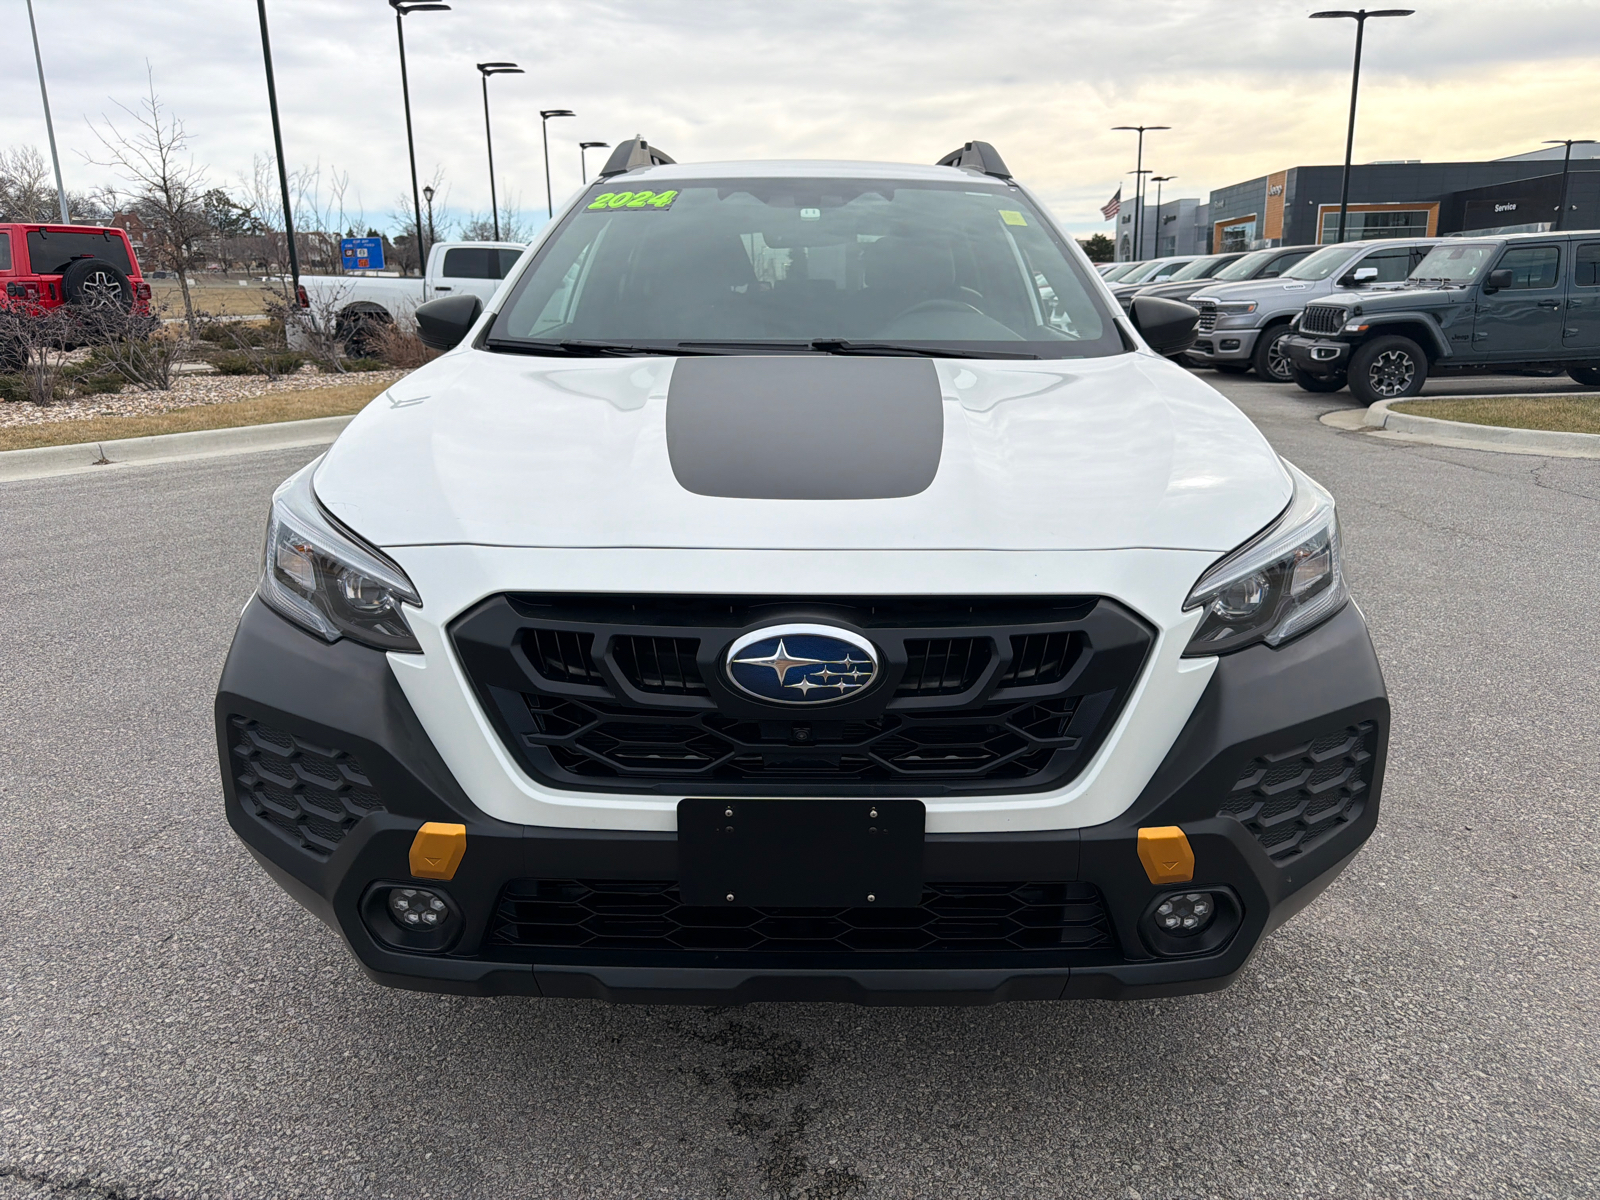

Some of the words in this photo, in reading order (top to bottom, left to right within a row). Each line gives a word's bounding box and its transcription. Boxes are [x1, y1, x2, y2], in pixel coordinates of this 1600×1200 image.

[1268, 184, 1283, 197] Jeep
[587, 190, 679, 210] 2024
[1494, 202, 1517, 213] Service
